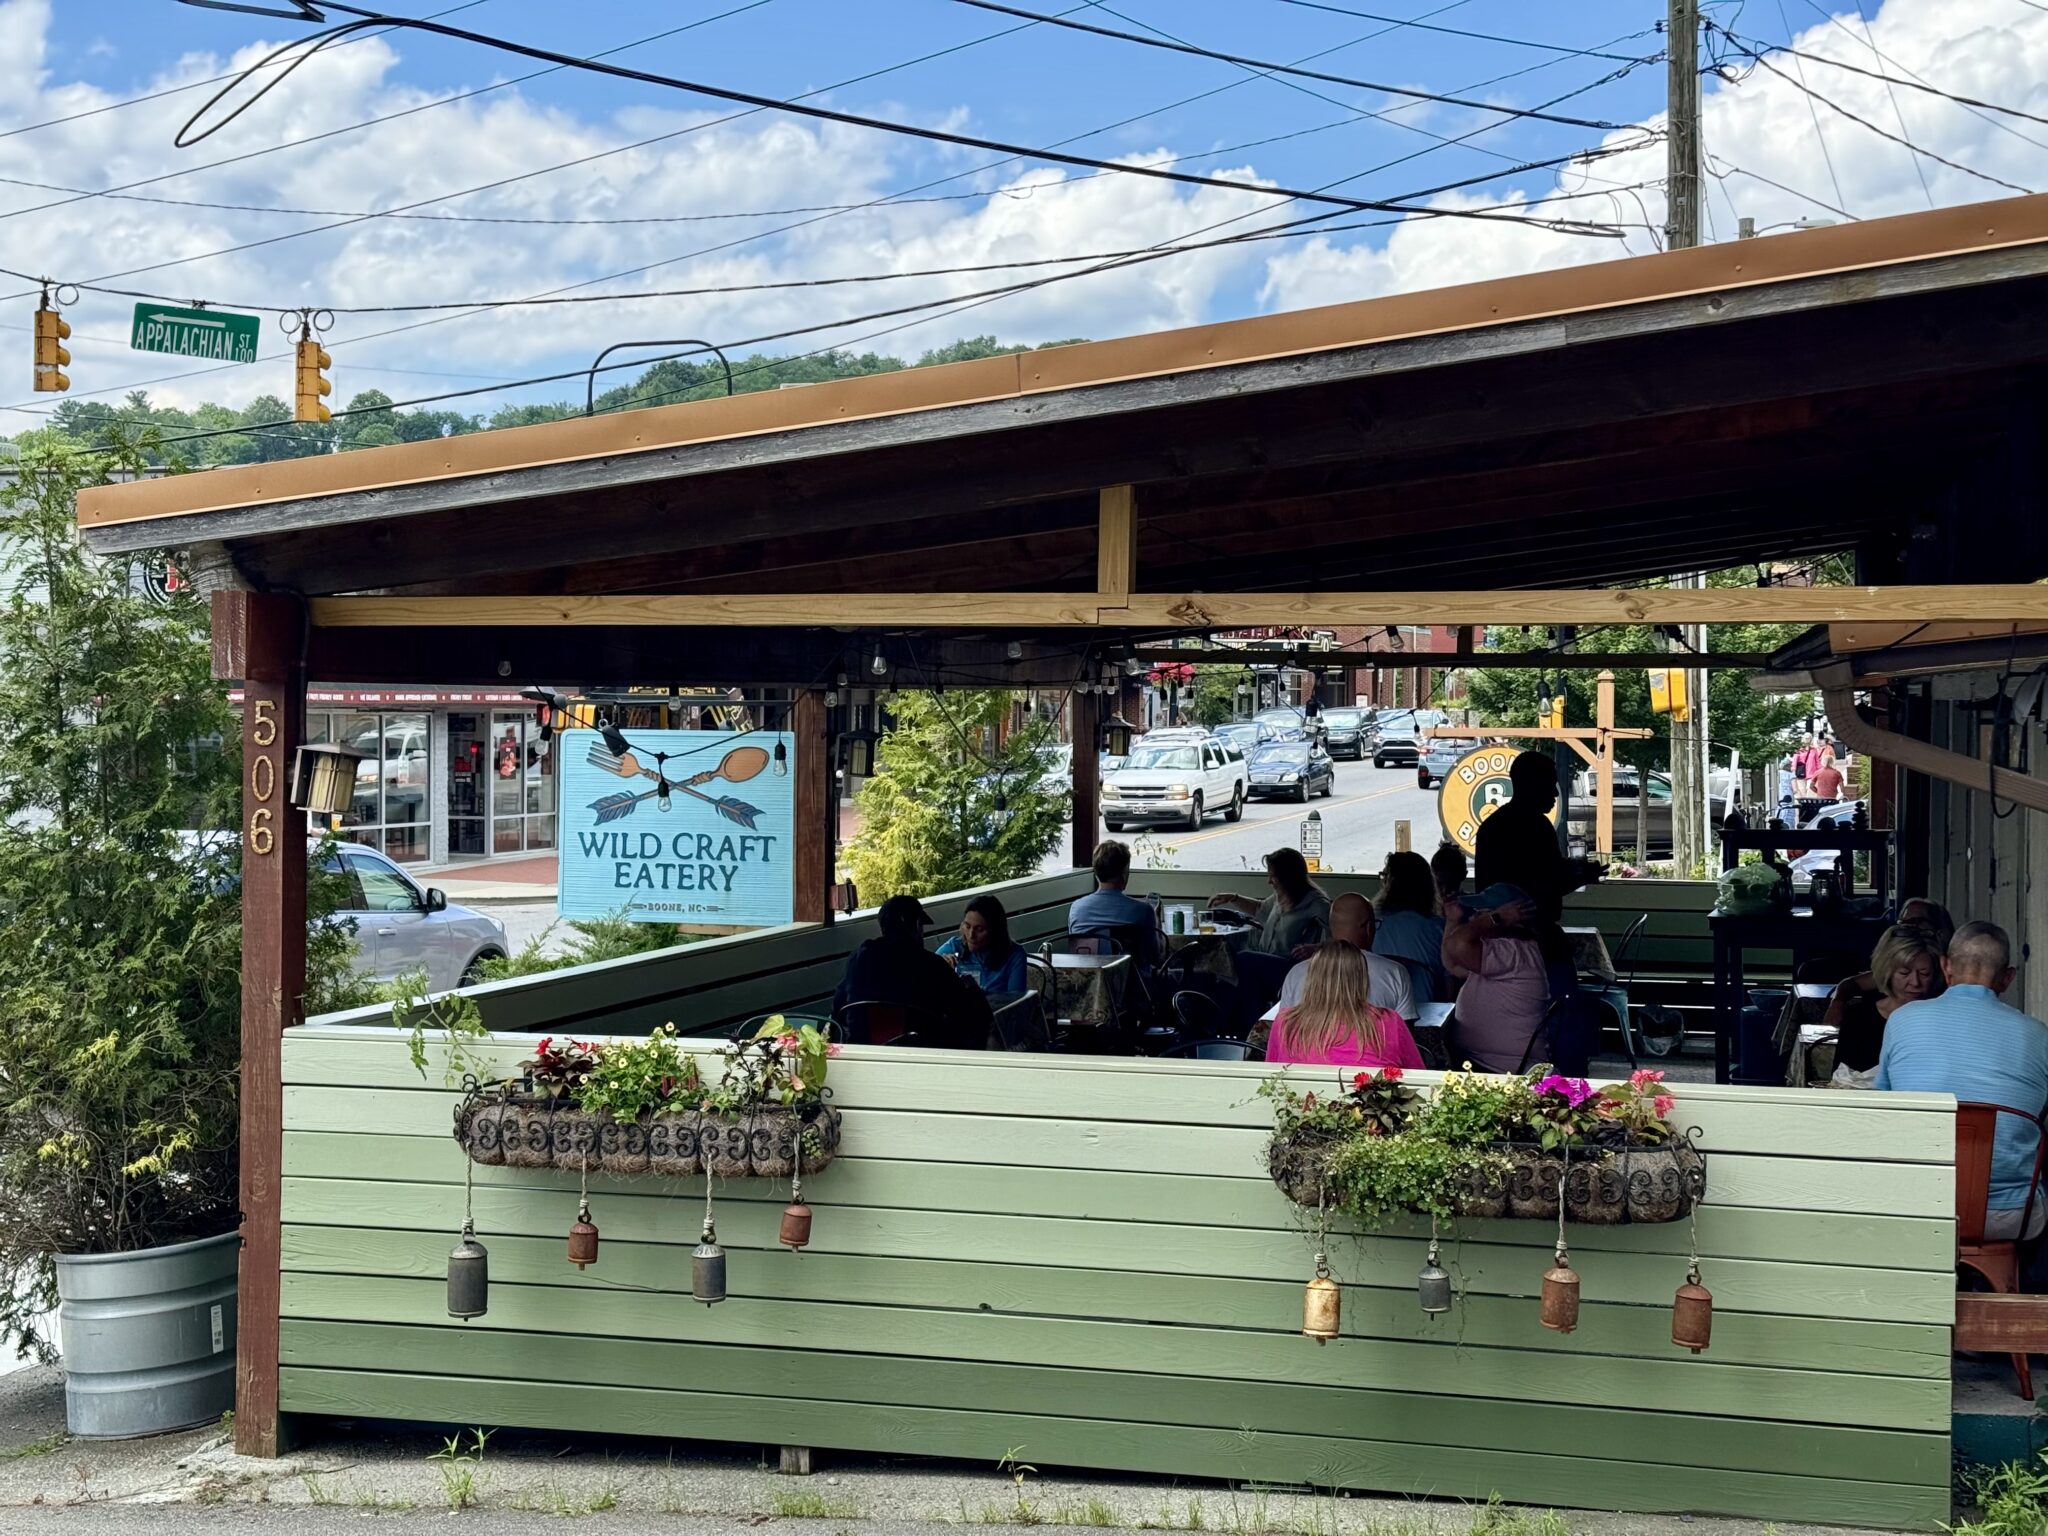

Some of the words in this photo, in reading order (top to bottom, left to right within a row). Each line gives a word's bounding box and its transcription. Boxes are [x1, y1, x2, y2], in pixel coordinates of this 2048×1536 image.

[134, 321, 234, 360] APPALACHIAN
[238, 333, 251, 349] ST
[234, 347, 254, 363] 100
[250, 700, 277, 855] 506
[577, 831, 663, 860] WILD
[672, 832, 777, 862] CRAFT
[614, 861, 739, 892] EATERY
[647, 903, 685, 913] BOONE,
[688, 904, 702, 913] NC
